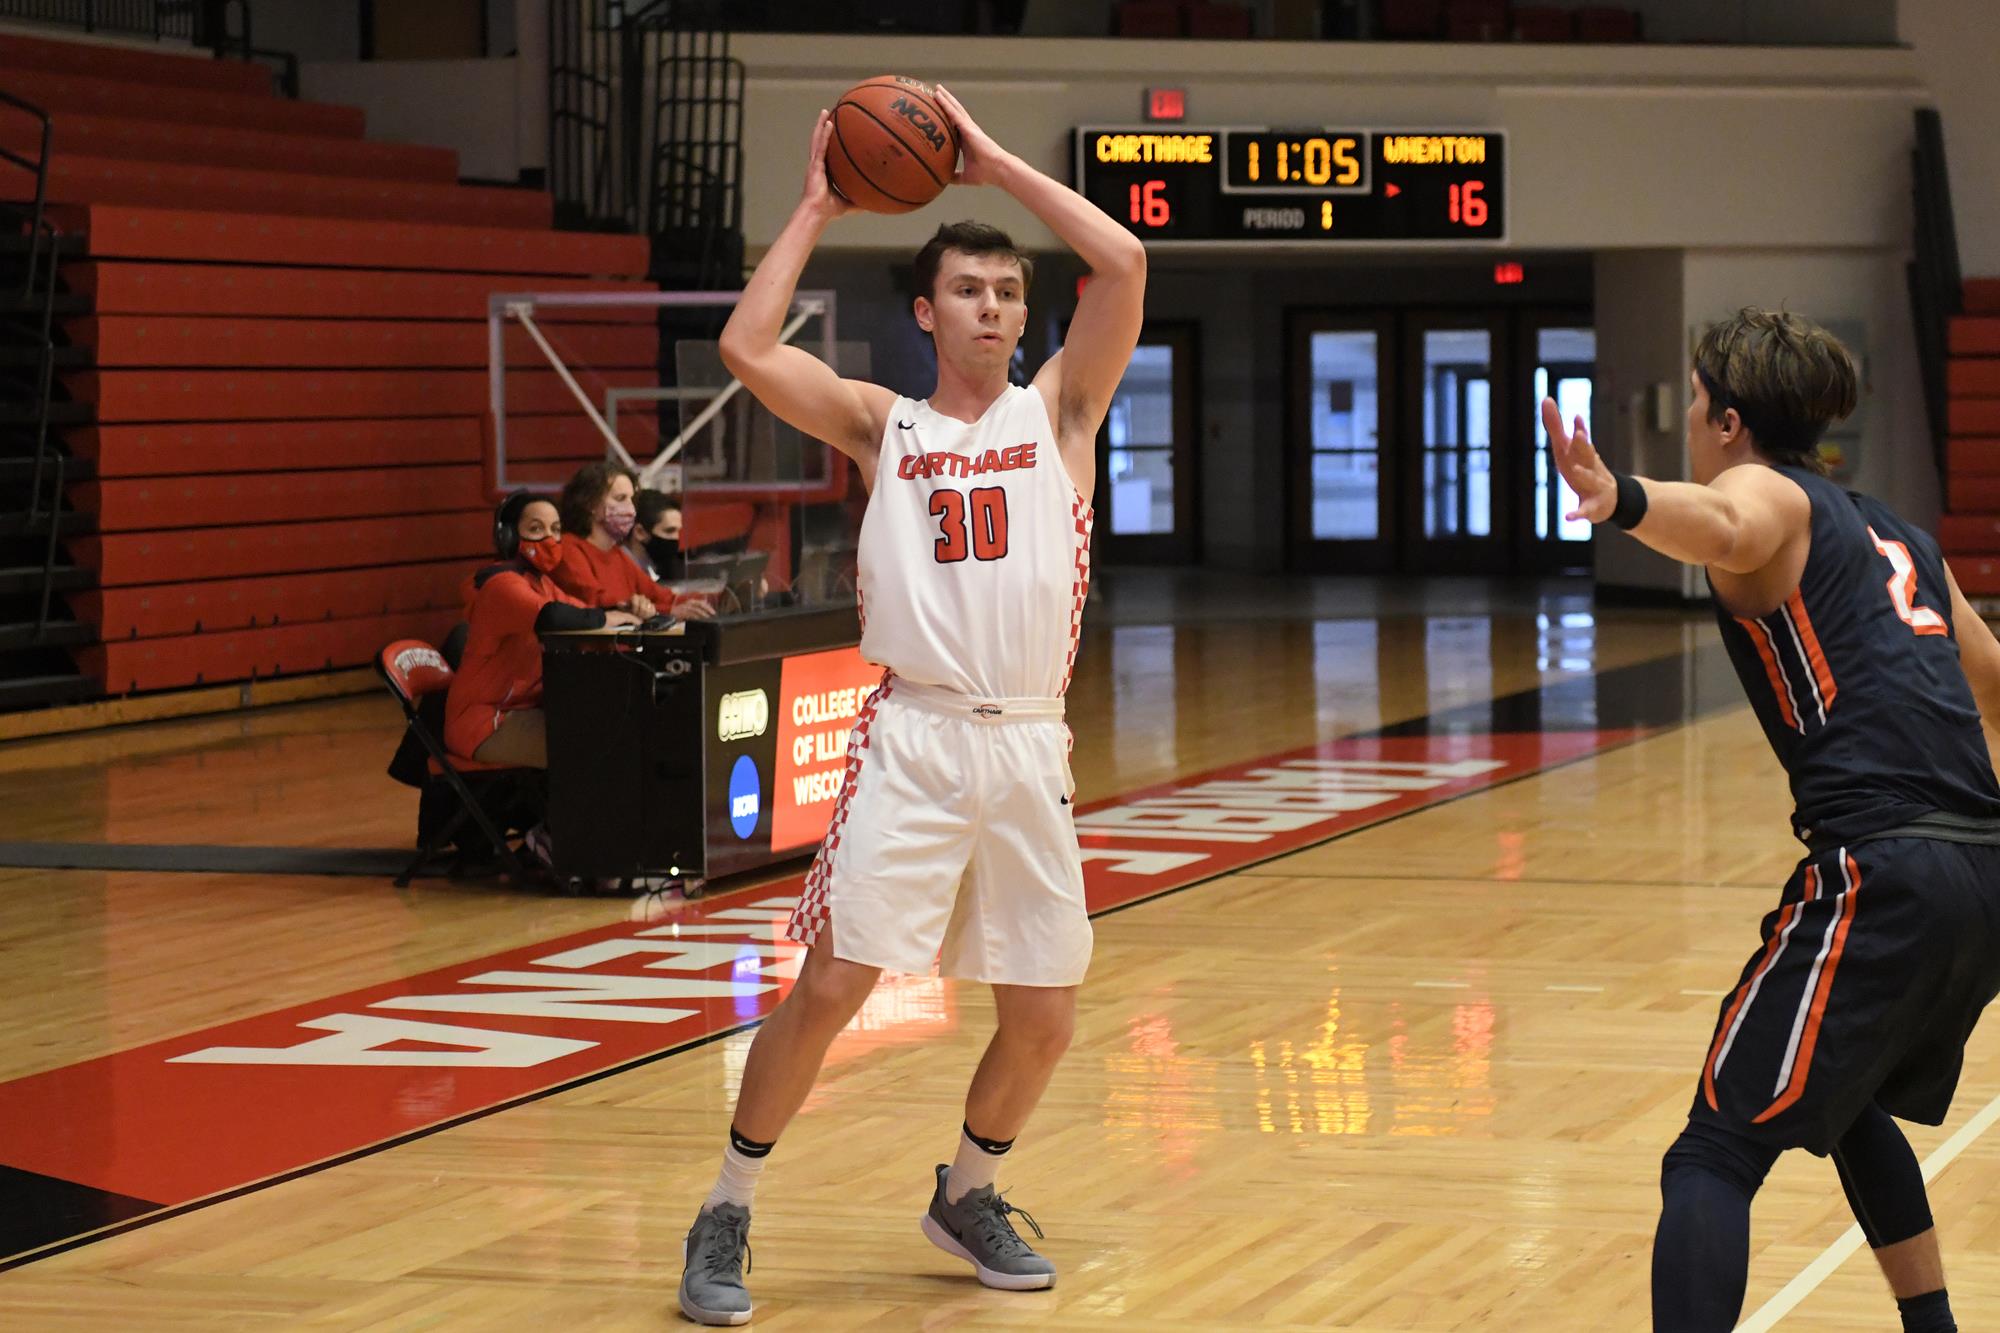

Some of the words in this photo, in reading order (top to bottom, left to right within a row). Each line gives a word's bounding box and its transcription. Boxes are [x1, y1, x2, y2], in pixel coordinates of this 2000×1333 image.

[890, 96, 946, 152] NCAA
[1097, 135, 1212, 163] CARTHAGE
[1248, 138, 1360, 185] 11:05
[1384, 136, 1486, 164] WHEATON
[1130, 180, 1170, 227] 16
[1243, 207, 1305, 229] PERIOD
[1449, 180, 1488, 227] 16
[897, 442, 1038, 480] CARTHAGE
[928, 486, 1009, 564] 30
[1866, 524, 1949, 638] 2
[793, 688, 856, 726] COLLEGE
[793, 735, 814, 766] OF
[164, 896, 809, 1068] ENA
